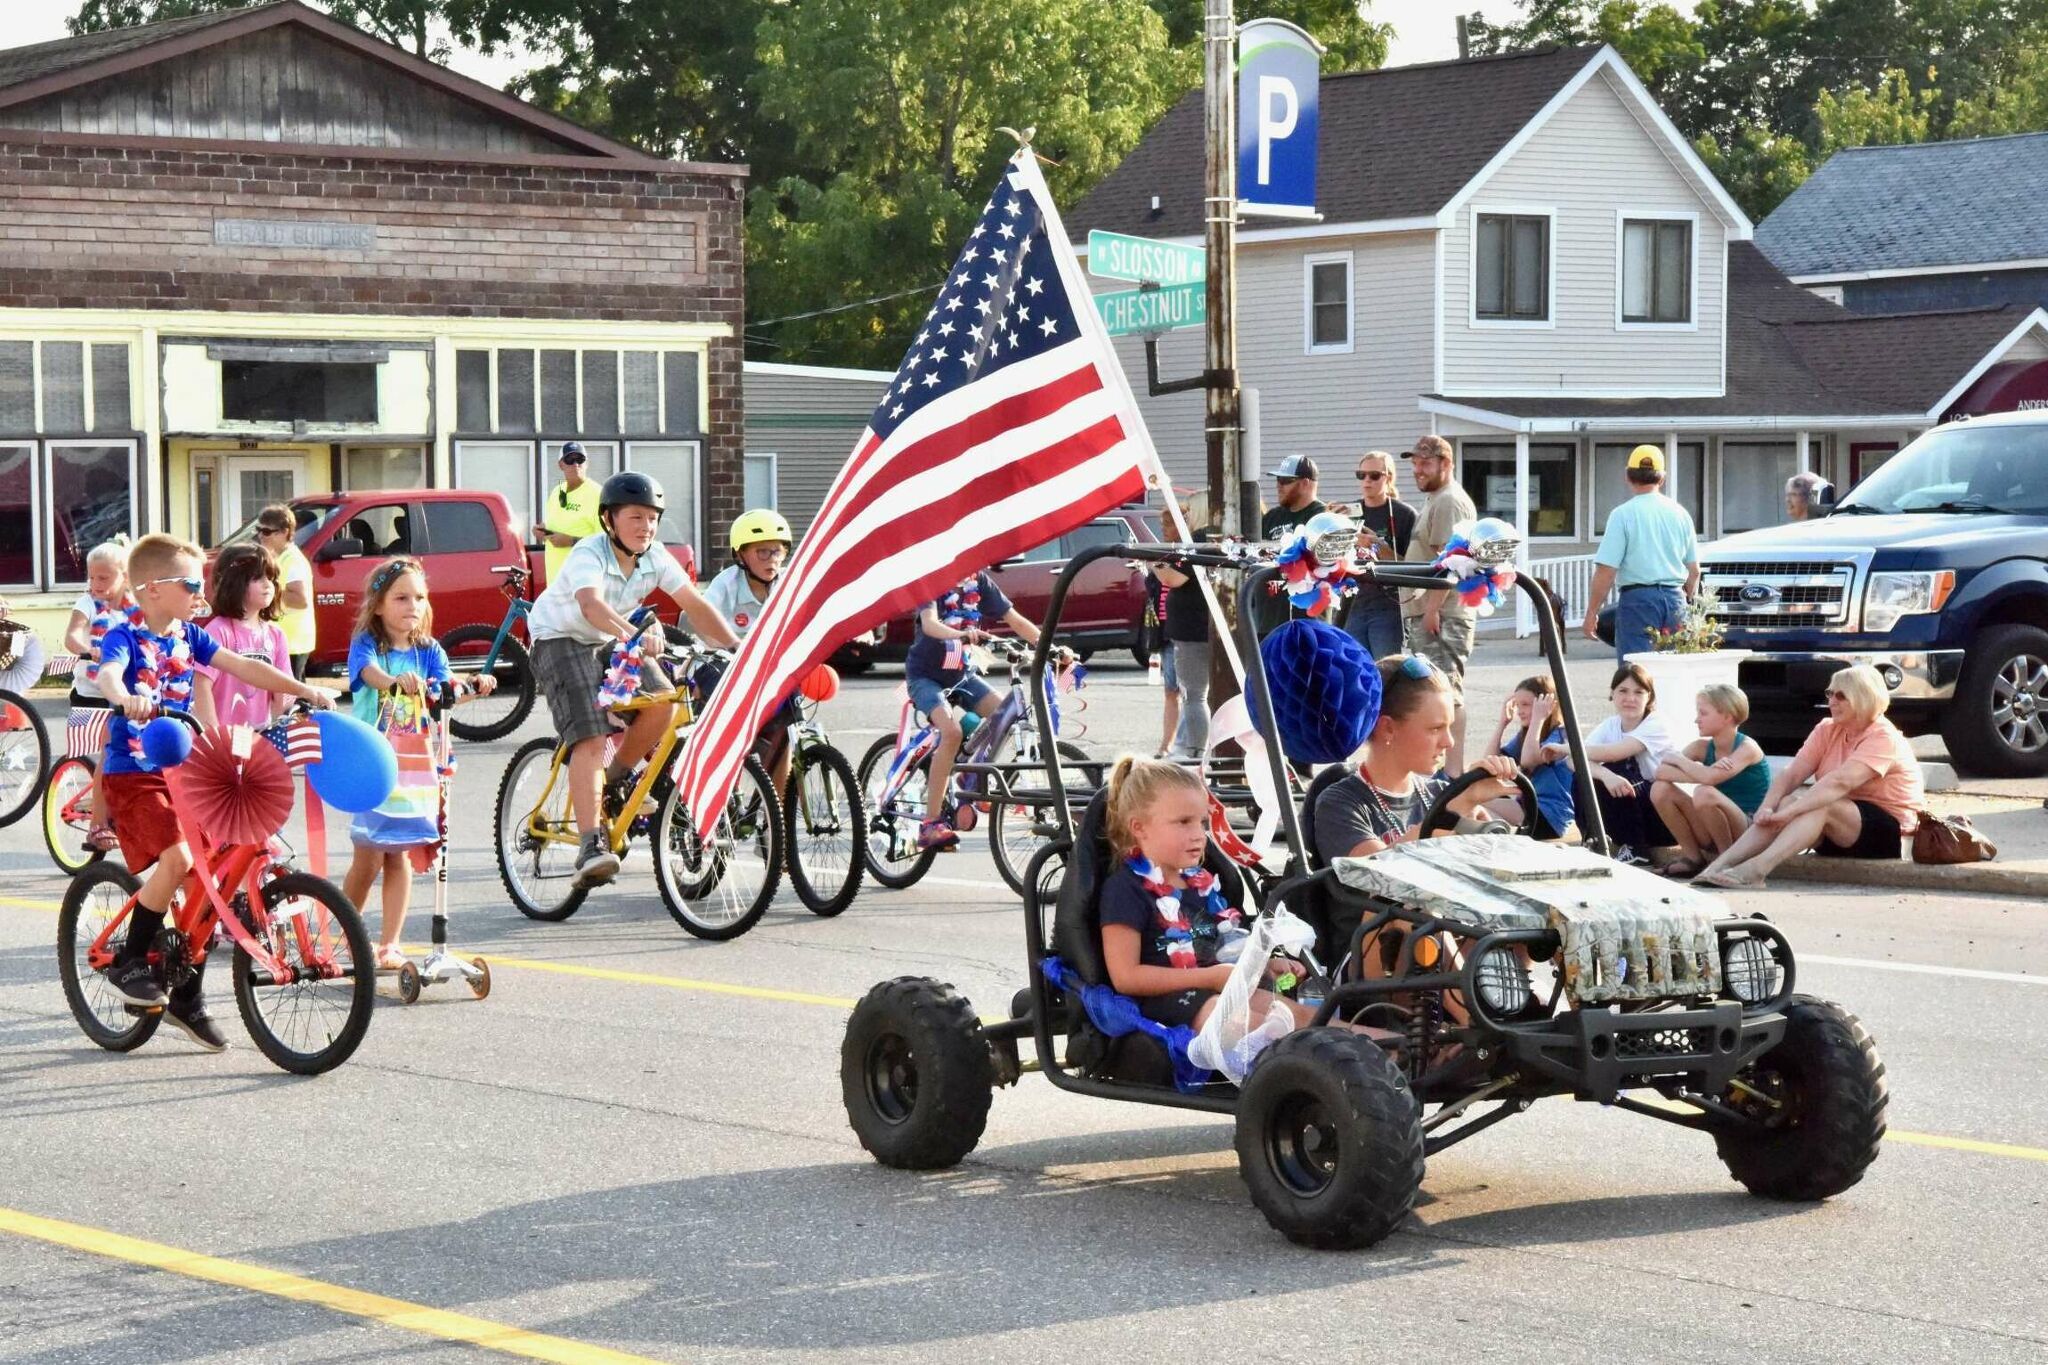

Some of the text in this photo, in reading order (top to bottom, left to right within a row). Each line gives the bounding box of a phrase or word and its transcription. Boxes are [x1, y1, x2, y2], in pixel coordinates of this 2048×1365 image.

[1258, 75, 1299, 185] P
[1110, 240, 1187, 282] SLOSSON
[1104, 288, 1192, 330] CHESTNUT
